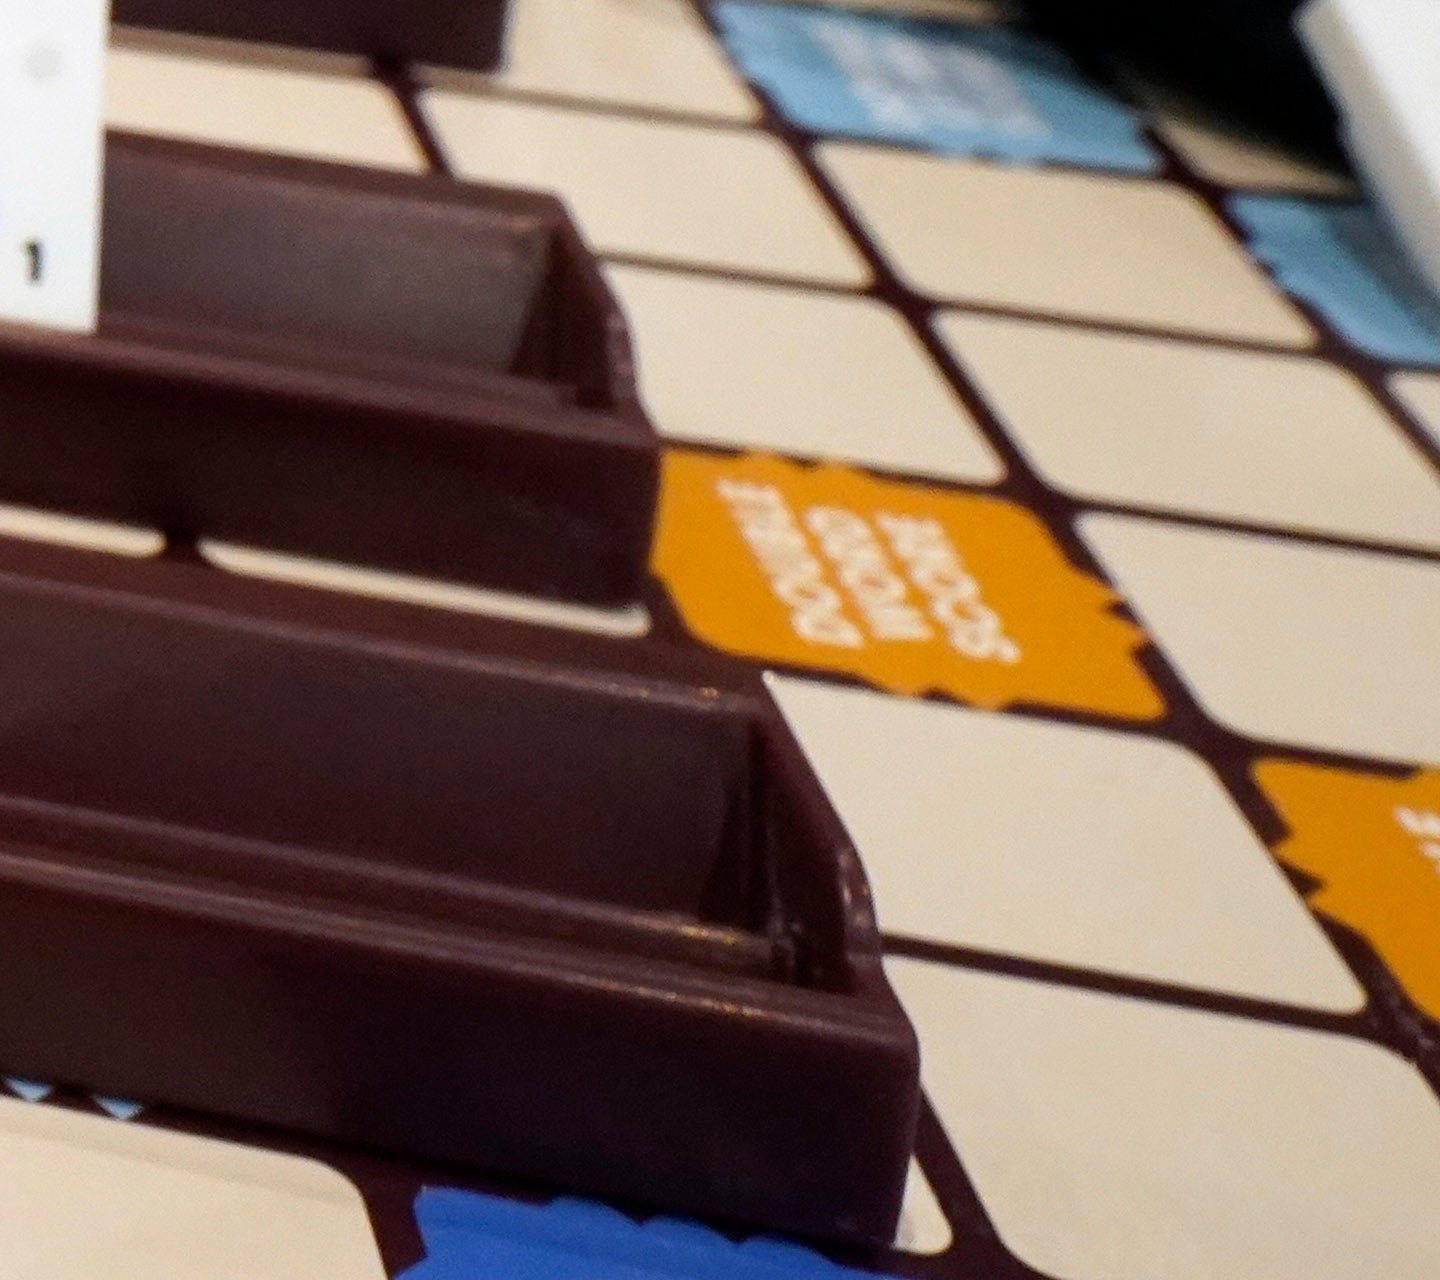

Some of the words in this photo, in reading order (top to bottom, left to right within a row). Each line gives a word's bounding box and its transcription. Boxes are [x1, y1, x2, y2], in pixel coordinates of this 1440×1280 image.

[25, 240, 44, 283] 1
[716, 479, 865, 648] DOUBLE
[802, 504, 934, 641] WORD
[873, 511, 1022, 664] SCORE
